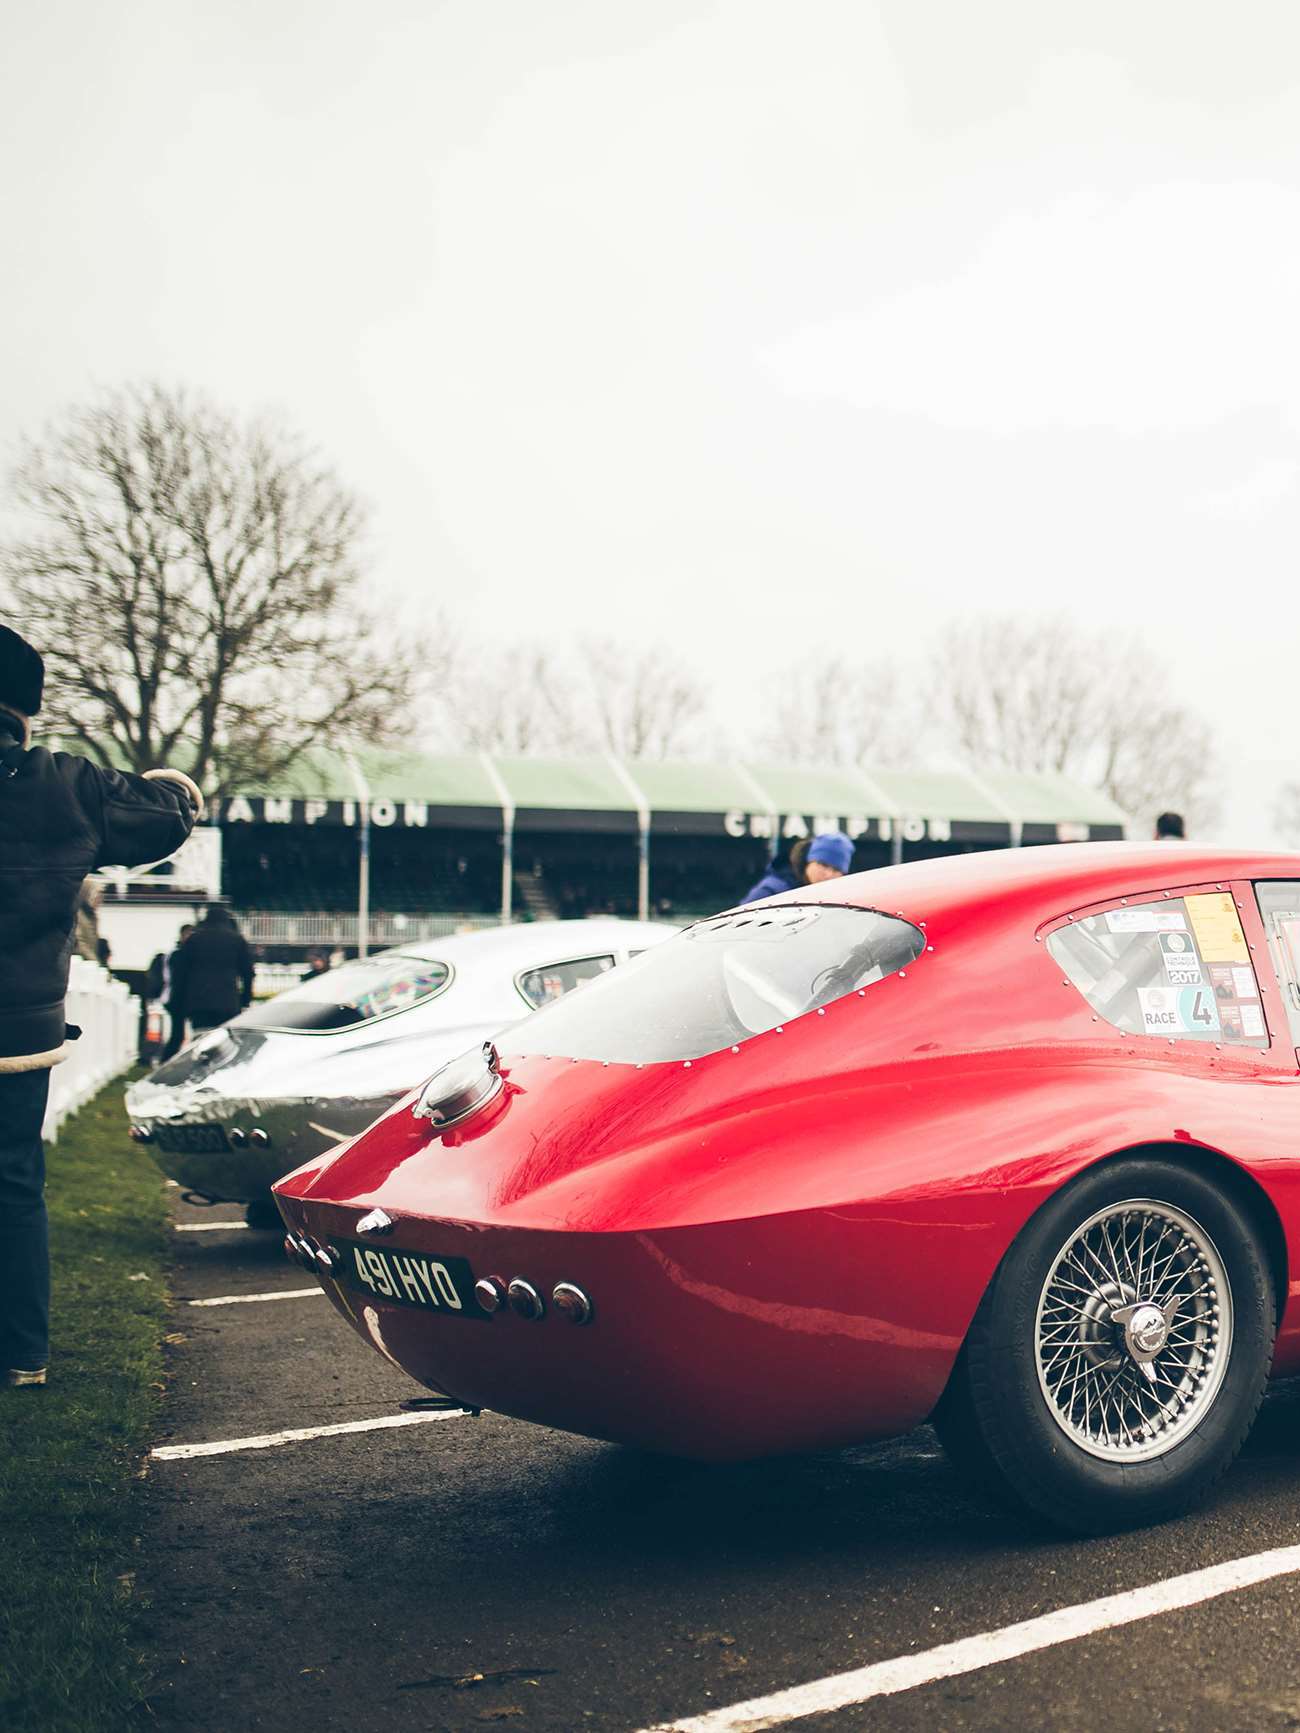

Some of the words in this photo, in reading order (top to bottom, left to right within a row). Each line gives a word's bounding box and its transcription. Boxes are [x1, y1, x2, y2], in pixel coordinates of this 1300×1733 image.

[201, 795, 429, 828] AMPION
[1170, 971, 1199, 984] 2017
[1145, 1012, 1177, 1025] RACE
[1192, 991, 1212, 1025] 4
